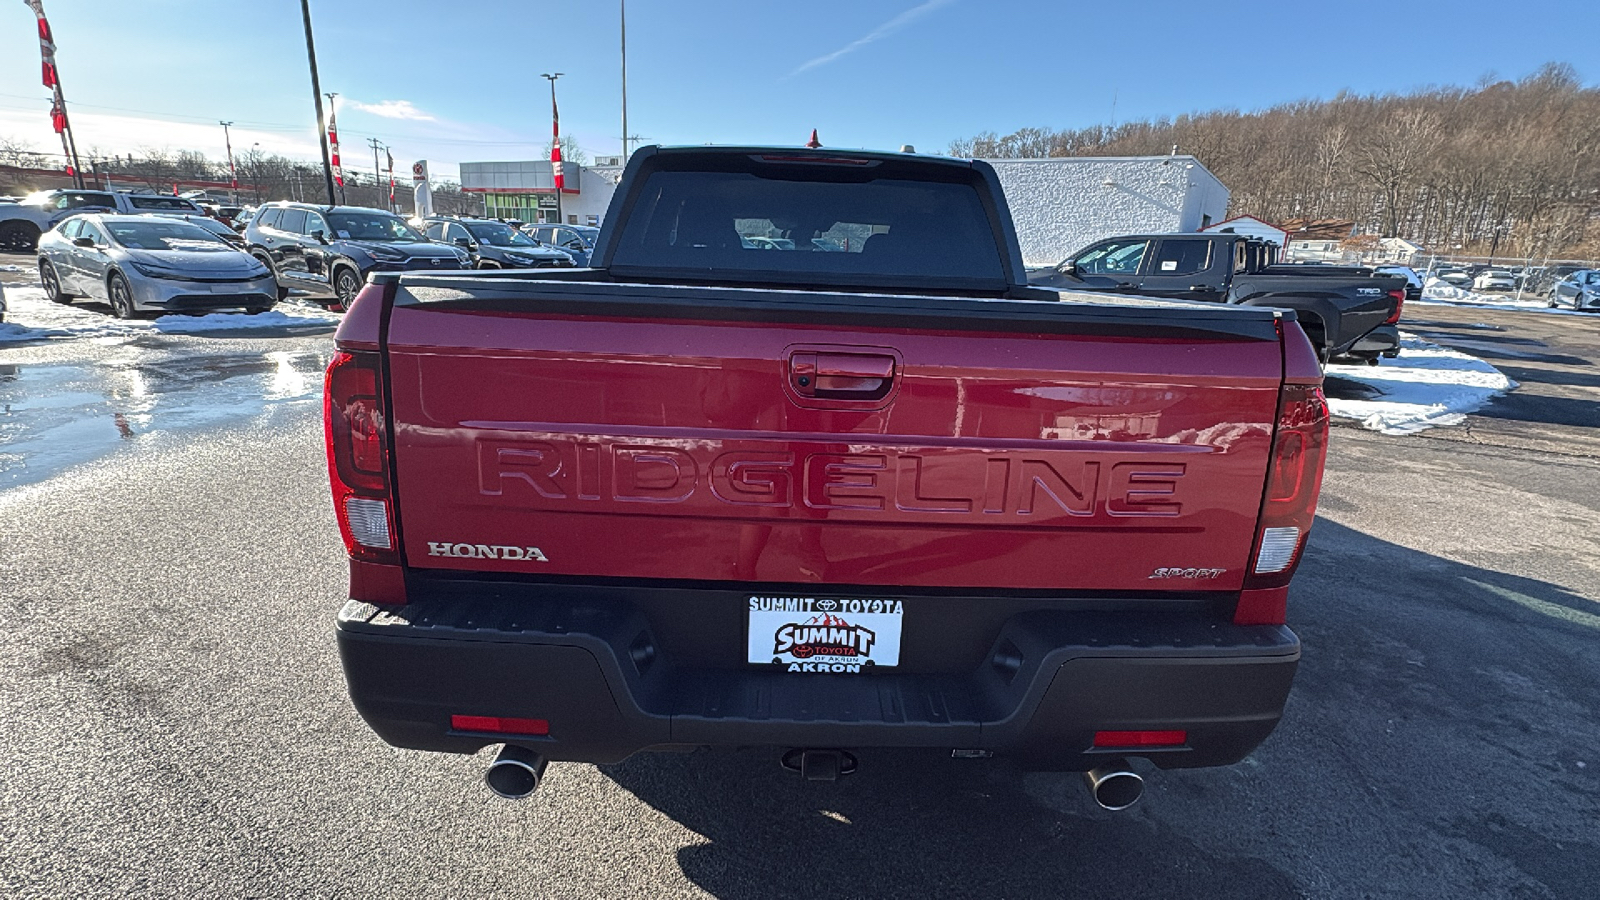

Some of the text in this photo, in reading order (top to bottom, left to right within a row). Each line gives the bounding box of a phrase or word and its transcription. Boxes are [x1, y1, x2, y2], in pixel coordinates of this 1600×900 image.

[476, 438, 1187, 518] RIDGELINE
[427, 541, 549, 562] HONDA
[1147, 567, 1227, 579] SPORT
[749, 596, 904, 615] SUMMIT TOYOTA
[775, 624, 874, 655] SUMMIT
[814, 646, 857, 656] TOYOTA
[787, 662, 861, 673] AKRON
